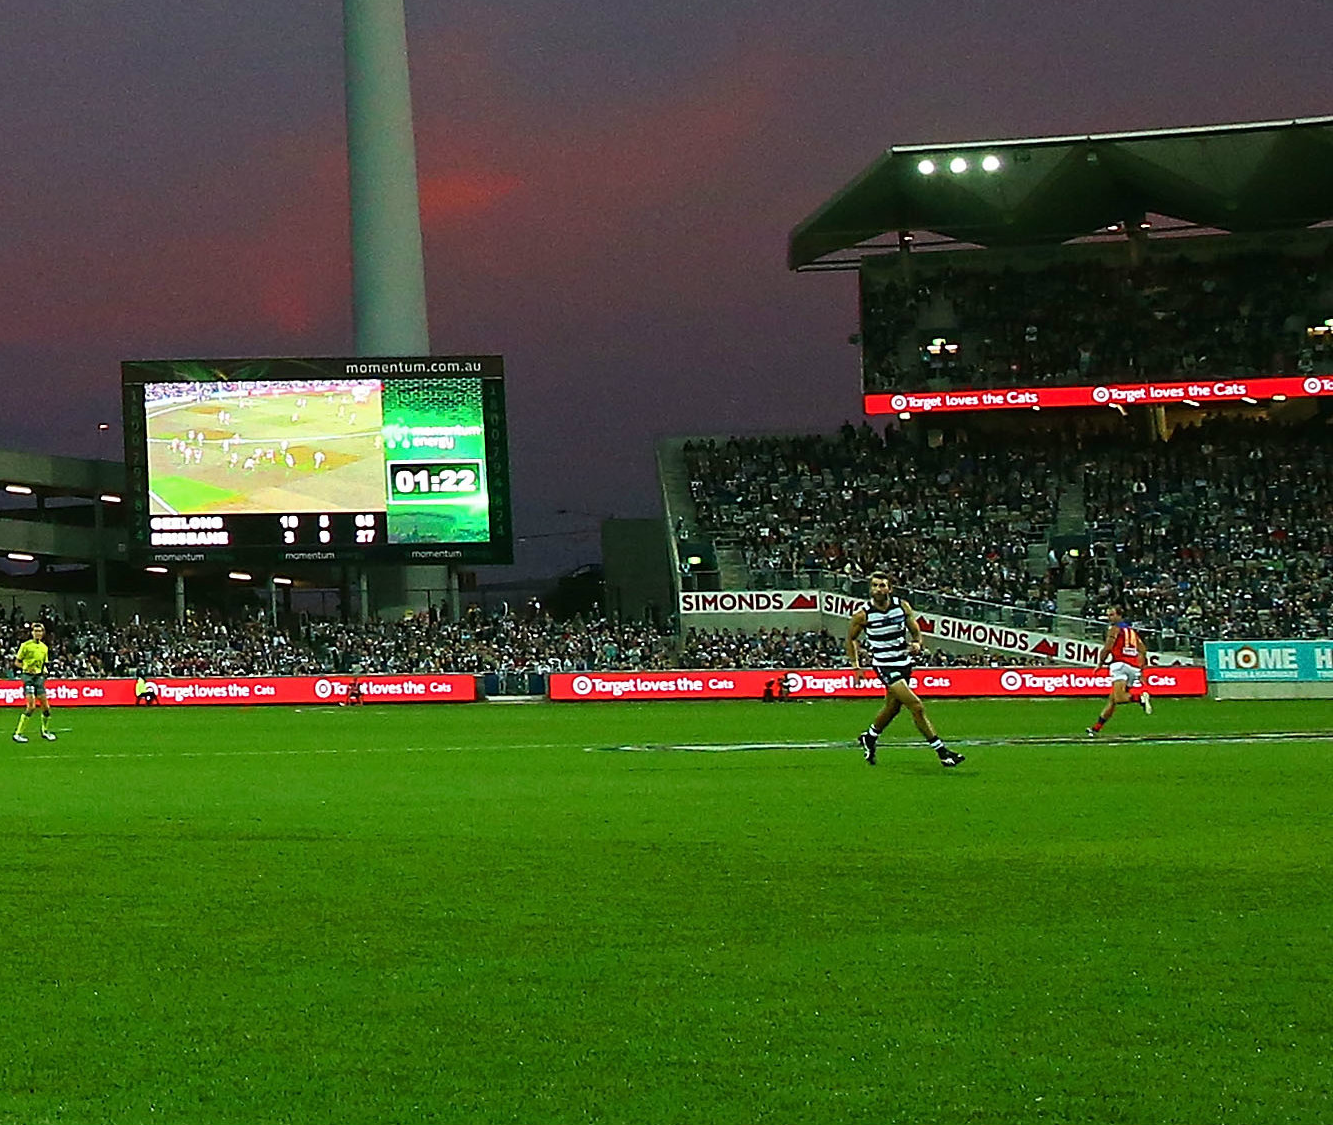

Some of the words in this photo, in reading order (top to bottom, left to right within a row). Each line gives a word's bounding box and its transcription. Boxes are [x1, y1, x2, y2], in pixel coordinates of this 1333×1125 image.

[346, 361, 481, 374] momentum.com.au
[906, 395, 943, 410] Target
[945, 393, 979, 406] loves
[982, 393, 1005, 405] the
[1007, 391, 1038, 404] Cats
[1109, 387, 1146, 402] Target
[1149, 386, 1183, 398] loves
[1187, 385, 1211, 397] the
[1213, 383, 1247, 396] Cats
[395, 469, 477, 493] 01:22
[682, 593, 784, 612] SIMONDS
[940, 617, 1029, 651] SIMONDS
[1218, 647, 1299, 670] HOME
[57, 683, 78, 699] the
[82, 686, 104, 698] Cats
[369, 681, 403, 695] loves
[403, 680, 425, 695] the
[429, 681, 452, 694] Cats
[592, 678, 635, 697] Target
[636, 678, 676, 692] loves
[676, 677, 703, 691] the
[708, 678, 734, 691] Cats
[802, 675, 847, 693] Target
[923, 675, 950, 687] Cats
[1022, 673, 1069, 692] Target
[1071, 673, 1112, 689] loves
[1148, 675, 1176, 687] Cats
[158, 683, 193, 702] Target
[194, 683, 227, 698] loves
[227, 683, 250, 697] the
[254, 684, 275, 697] Cats
